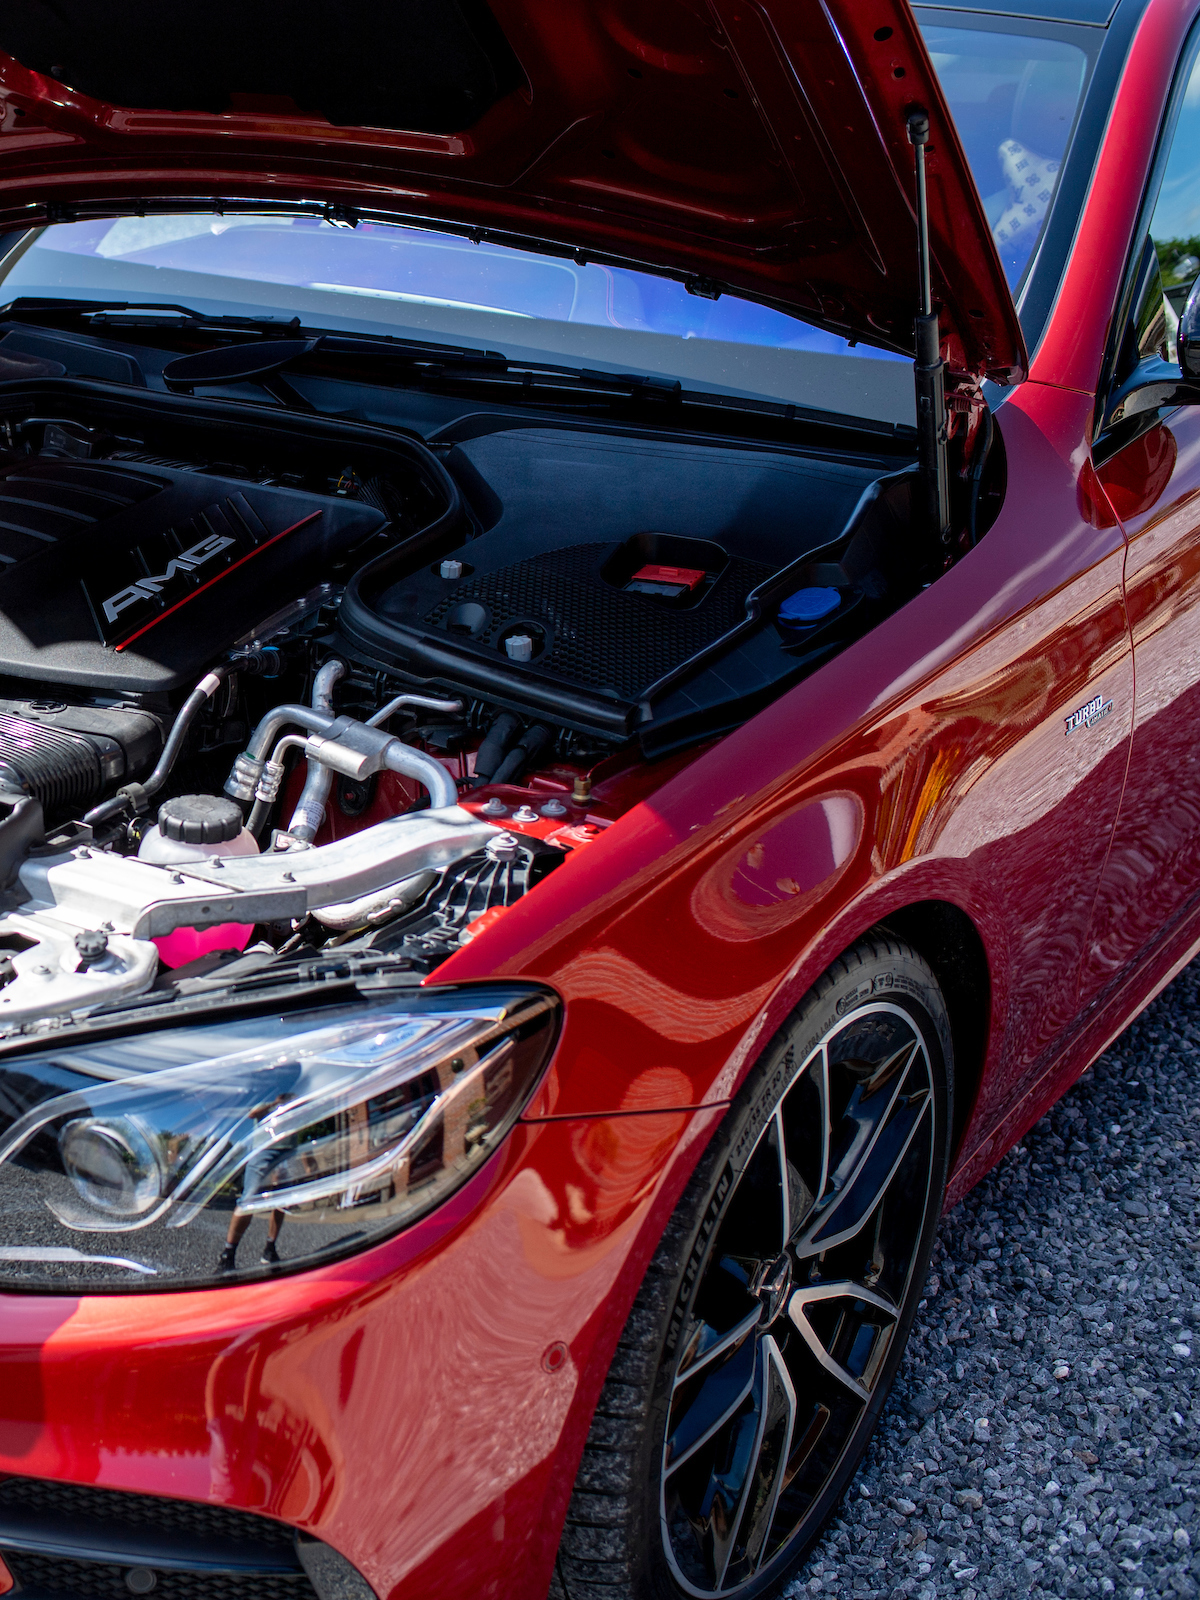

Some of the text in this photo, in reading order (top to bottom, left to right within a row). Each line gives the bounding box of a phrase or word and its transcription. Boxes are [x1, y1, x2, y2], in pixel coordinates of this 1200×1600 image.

[102, 533, 237, 624] AMG
[1065, 695, 1103, 730] TURBO
[666, 1174, 729, 1350] MICHELIN
